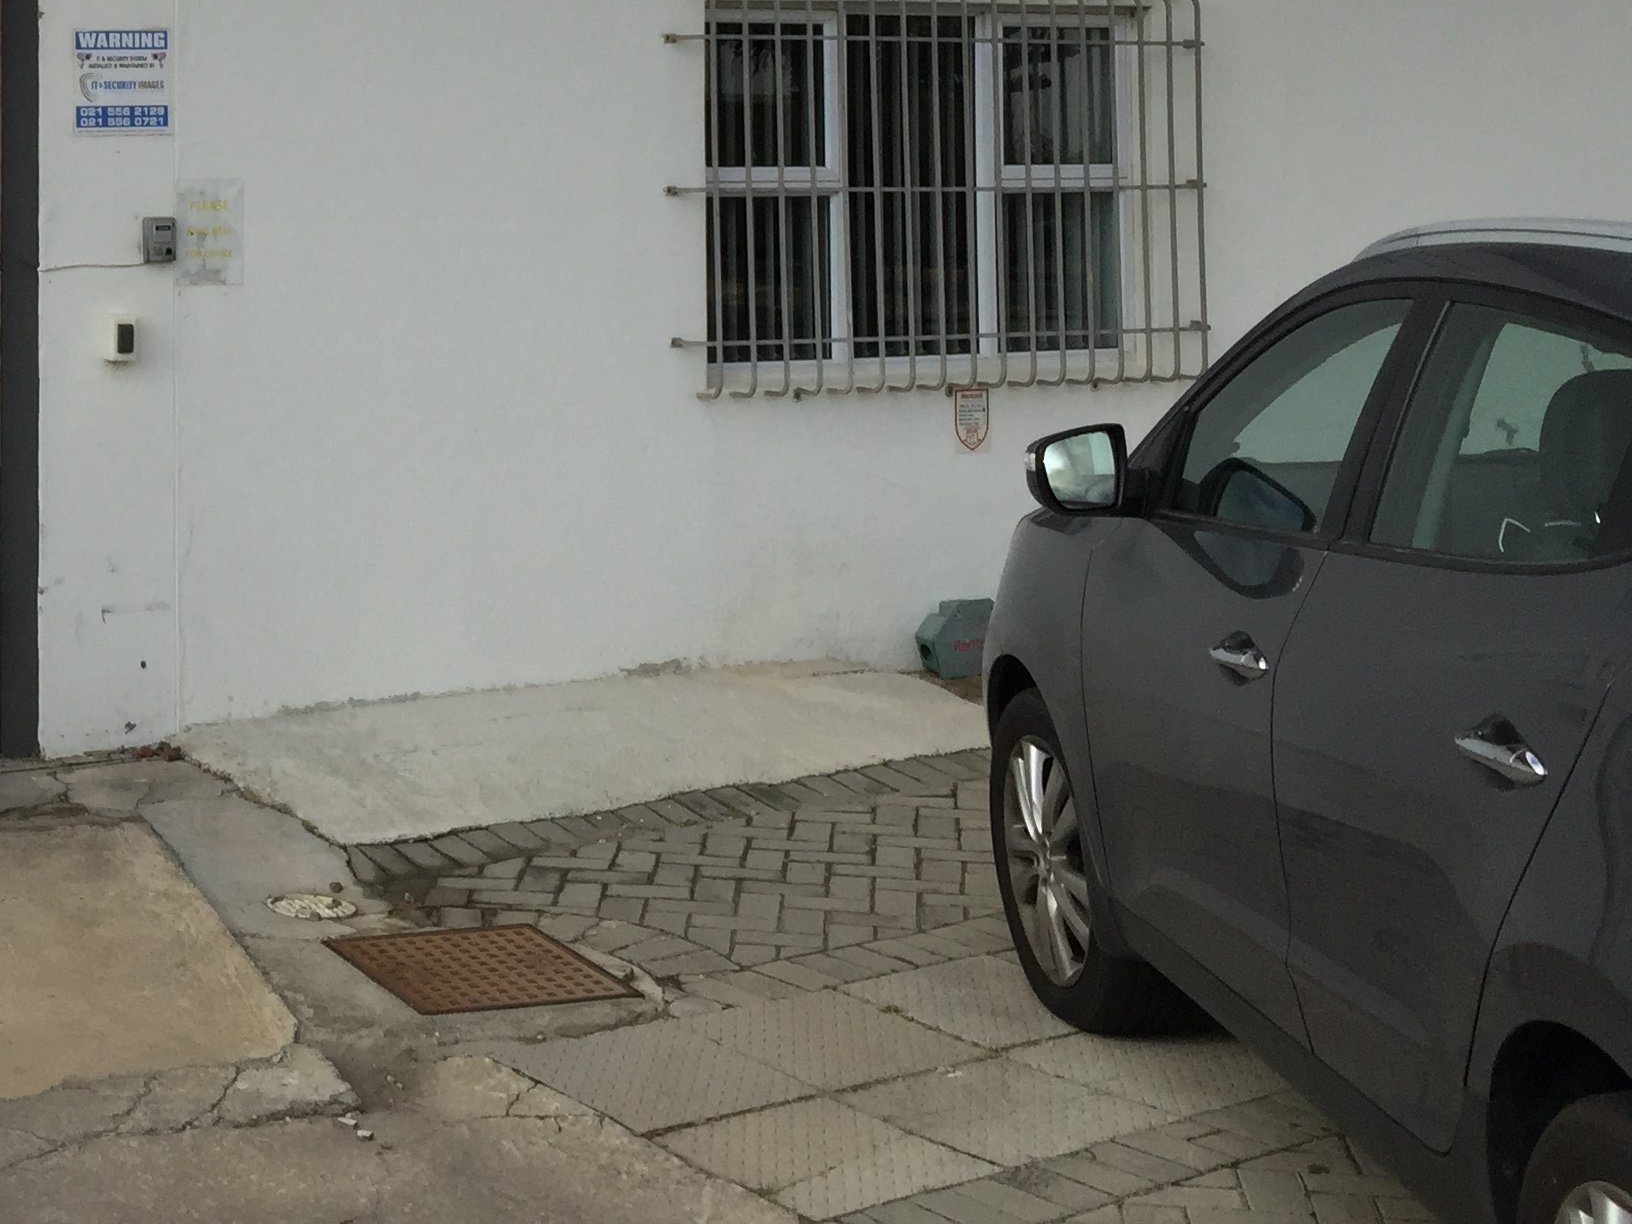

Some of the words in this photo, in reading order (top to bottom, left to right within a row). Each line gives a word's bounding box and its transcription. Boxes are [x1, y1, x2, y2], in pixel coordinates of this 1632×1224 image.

[78, 32, 165, 48] WARNING
[103, 80, 137, 90] SECURITY
[80, 107, 102, 116] 021
[80, 117, 102, 126] 021
[134, 117, 165, 126] 0721
